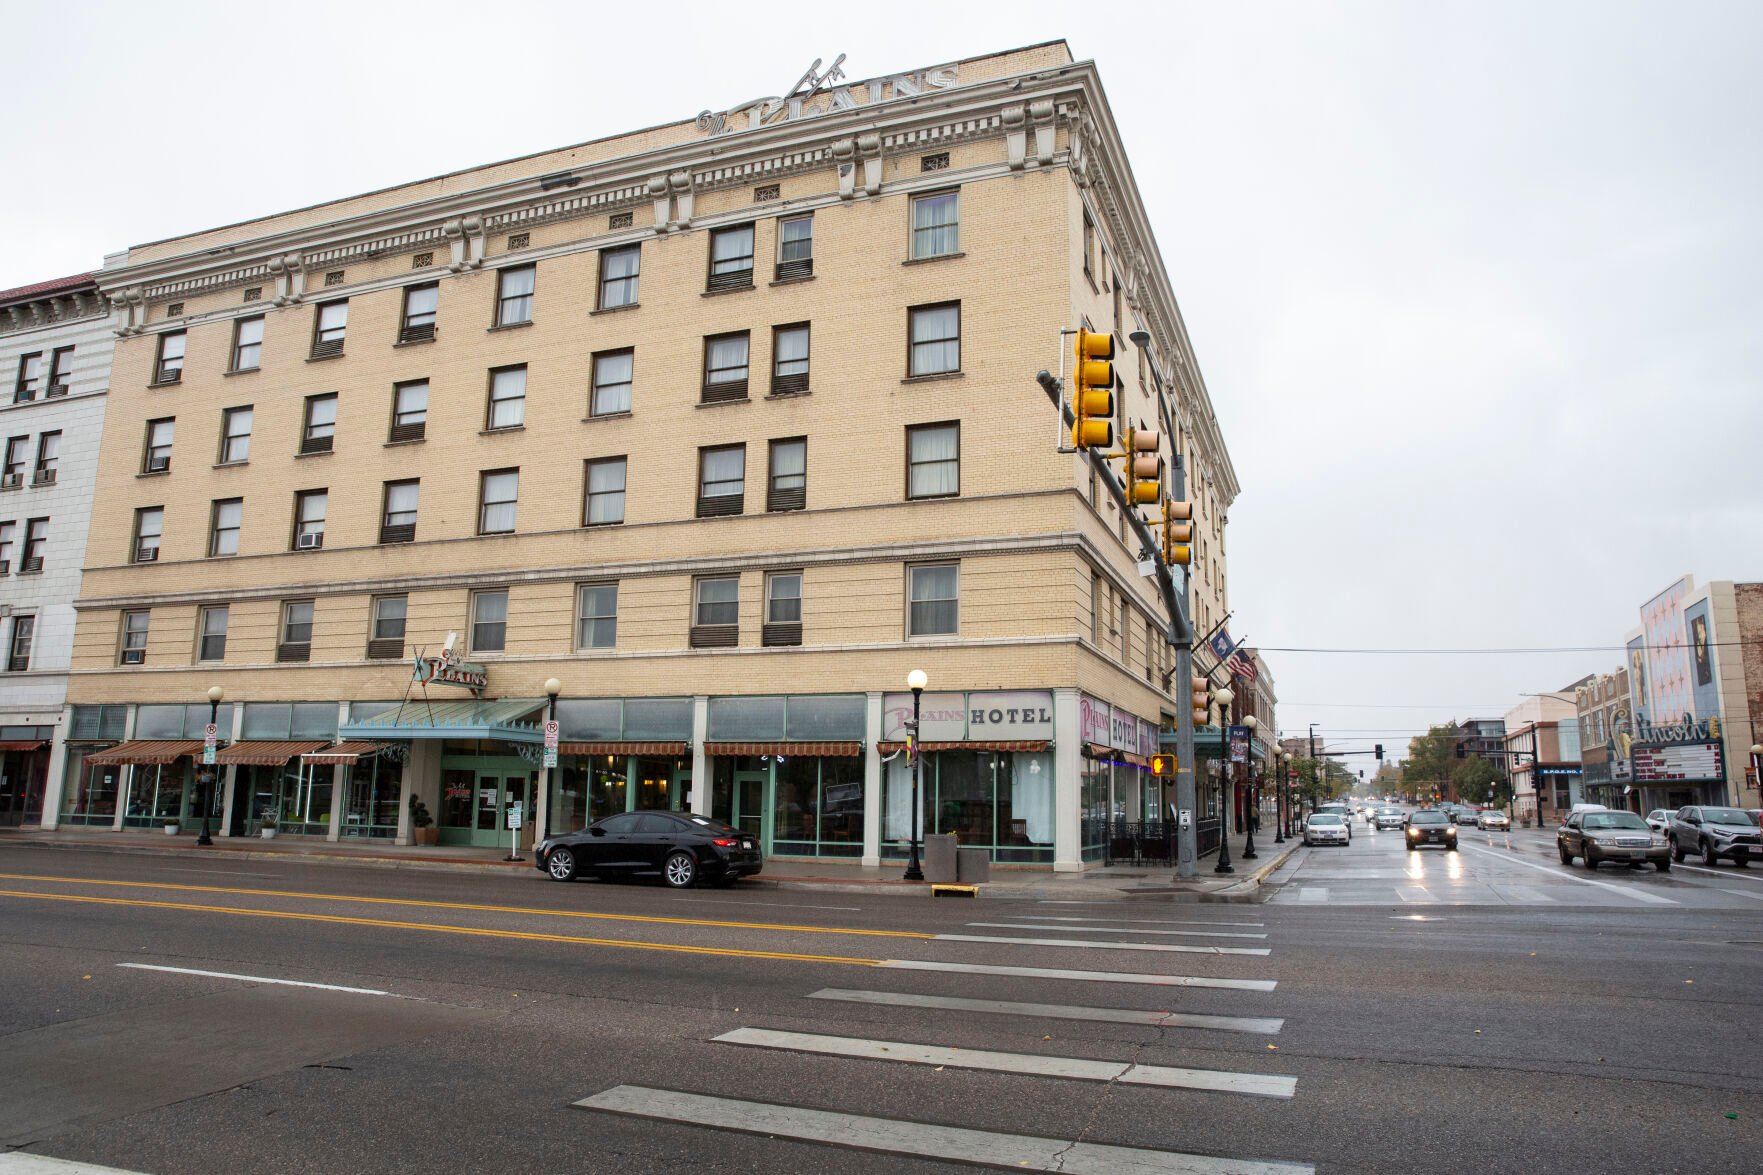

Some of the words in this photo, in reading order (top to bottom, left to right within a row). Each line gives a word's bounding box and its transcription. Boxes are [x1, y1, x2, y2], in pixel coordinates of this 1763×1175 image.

[423, 656, 488, 687] PLAINS
[971, 708, 1051, 724] HOTEL
[1633, 711, 1707, 744] Lincoln
[1112, 718, 1136, 746] HOTEL
